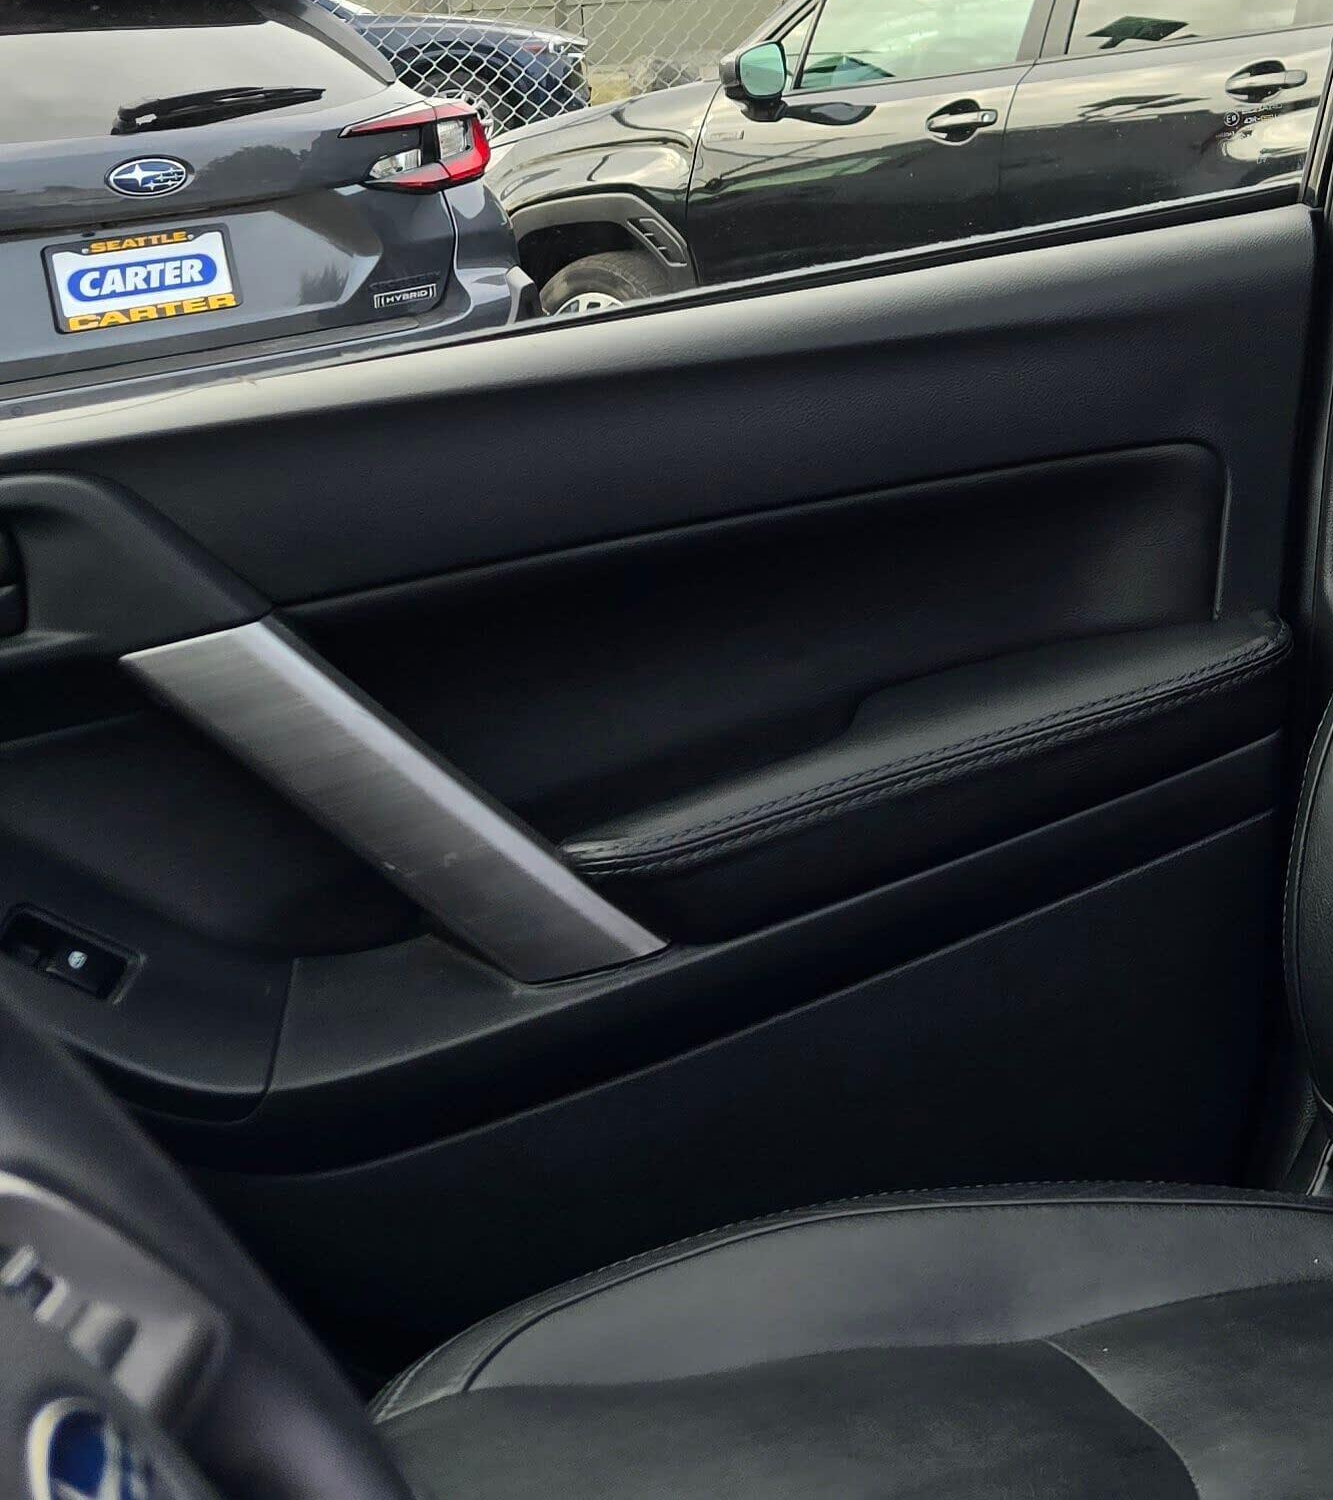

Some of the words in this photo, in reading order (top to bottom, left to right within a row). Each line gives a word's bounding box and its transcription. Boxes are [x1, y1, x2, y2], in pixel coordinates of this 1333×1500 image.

[88, 231, 189, 253] SEATTLE
[79, 258, 204, 298] CARTER
[386, 289, 429, 304] HYBRID
[68, 293, 237, 331] CARTER
